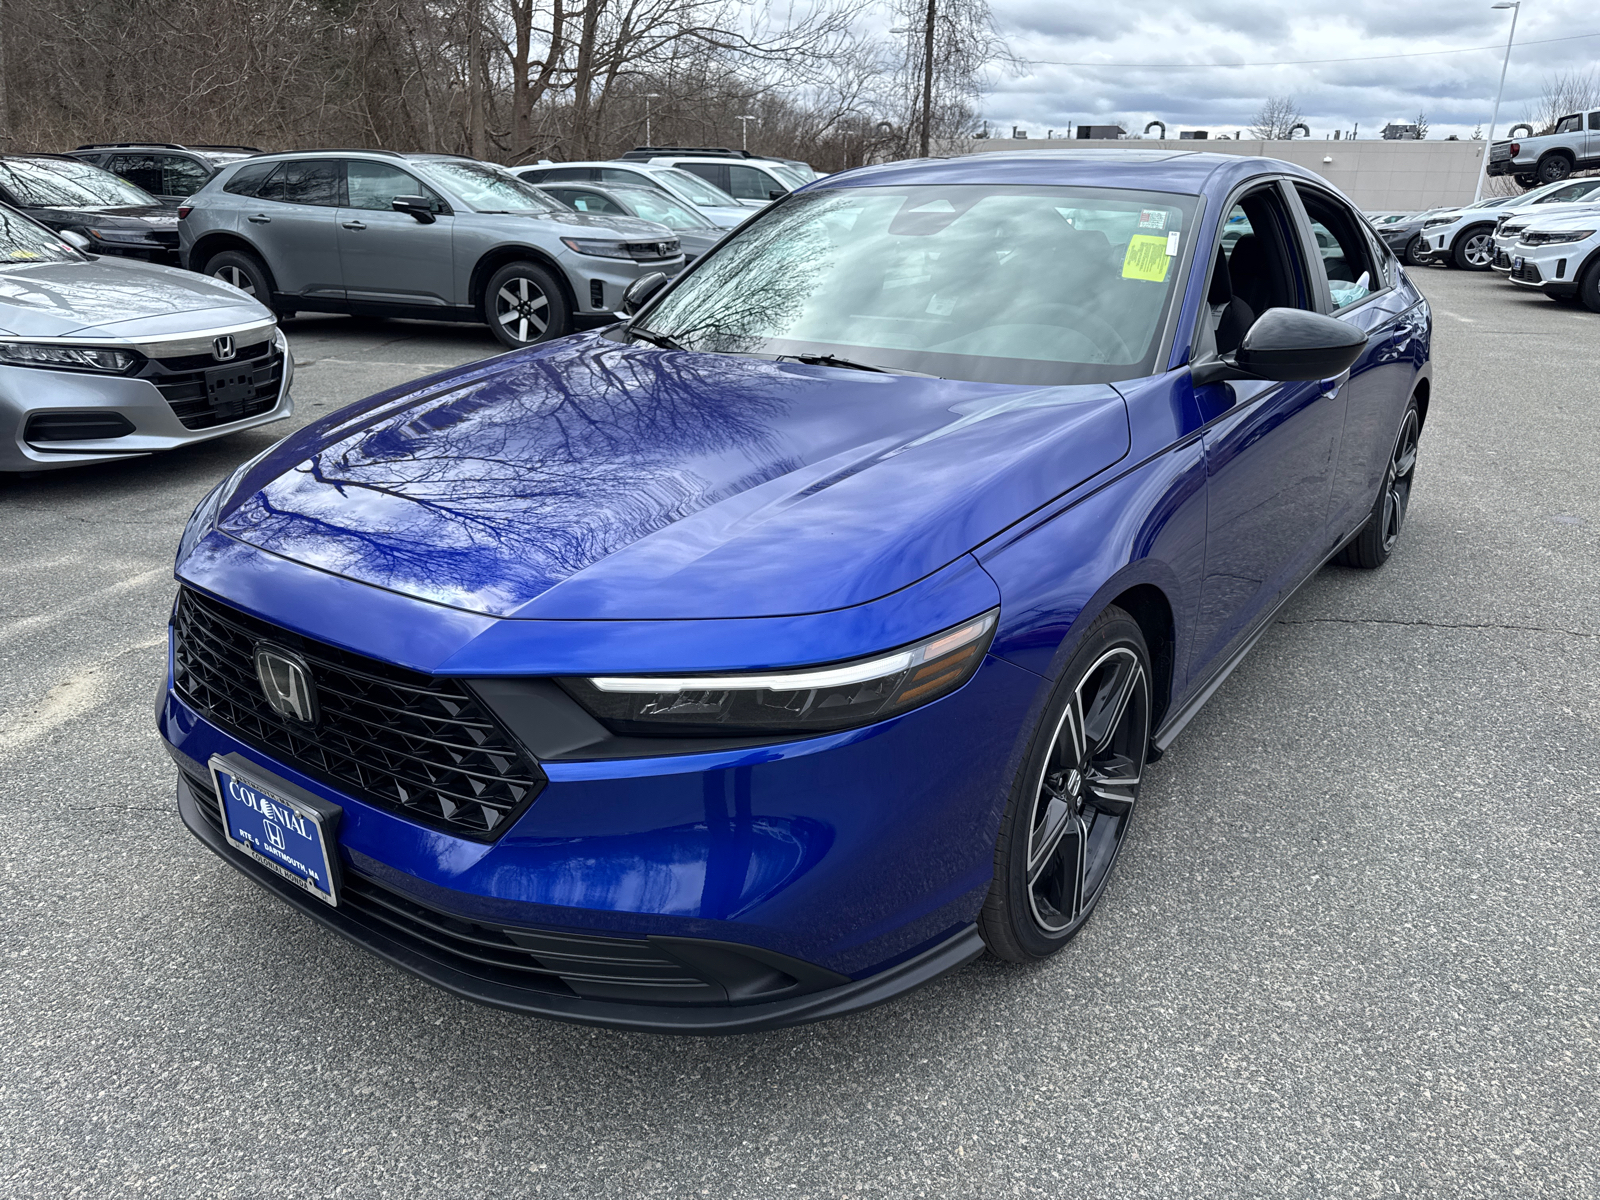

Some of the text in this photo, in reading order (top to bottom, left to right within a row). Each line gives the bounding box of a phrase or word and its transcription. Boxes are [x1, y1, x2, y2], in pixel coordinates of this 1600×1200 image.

[229, 781, 312, 841] COLONIAL
[239, 828, 320, 881] RTE. 6 DARTMOUTH, MA
[251, 851, 284, 876] COLONIAL
